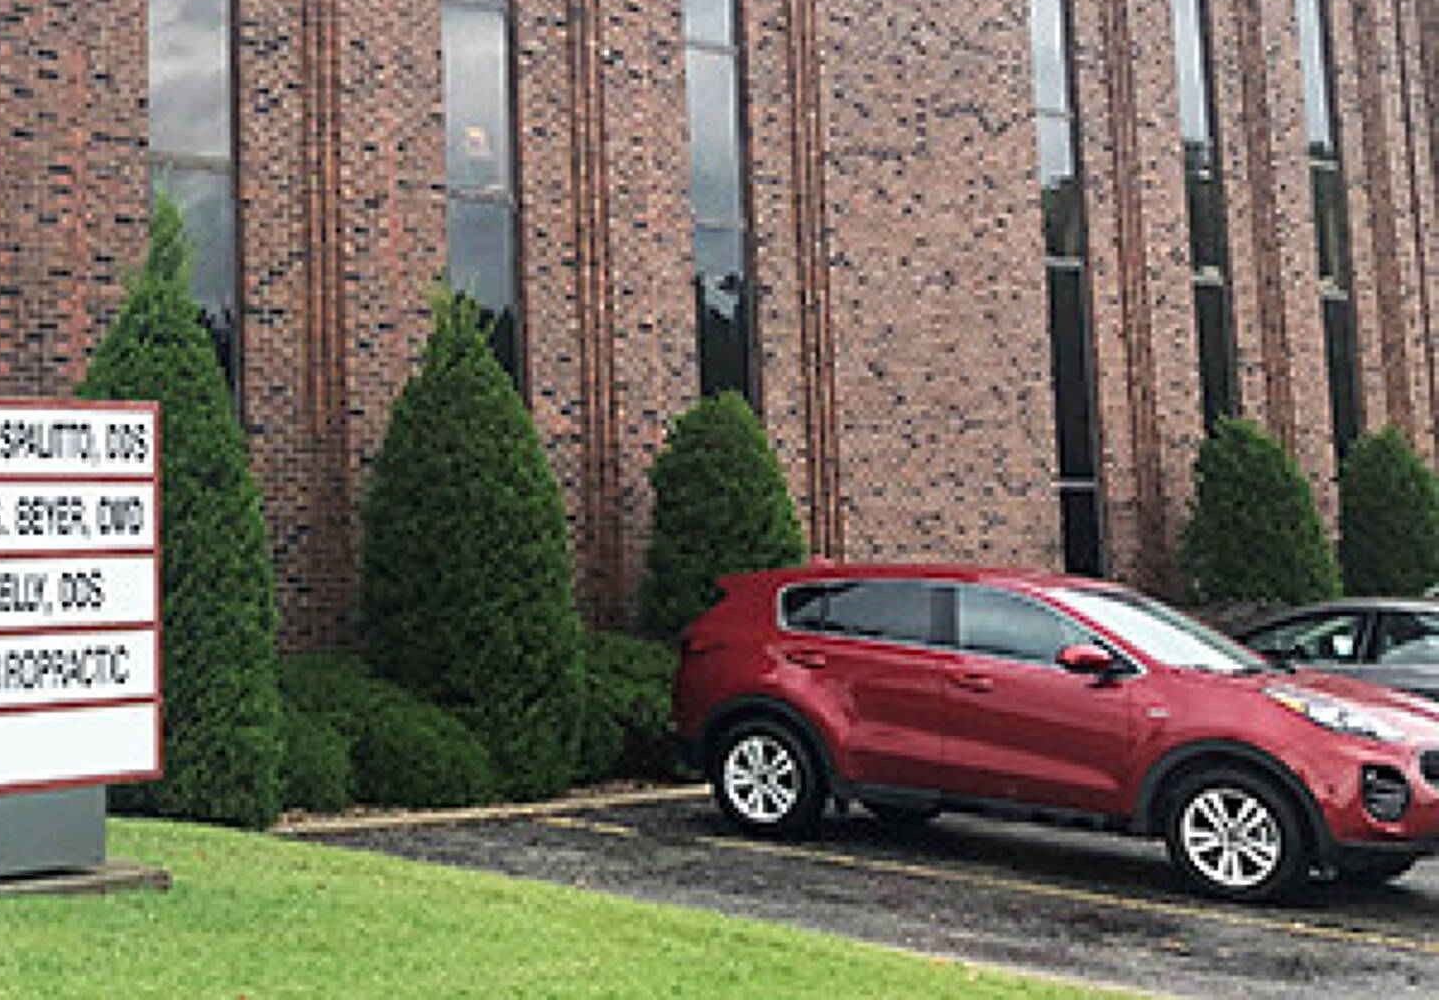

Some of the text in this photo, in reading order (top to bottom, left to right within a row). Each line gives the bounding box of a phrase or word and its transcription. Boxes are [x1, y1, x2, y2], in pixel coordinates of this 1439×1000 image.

[105, 423, 148, 462] DDS
[15, 496, 91, 540] BEYER,
[58, 569, 106, 612] DDS
